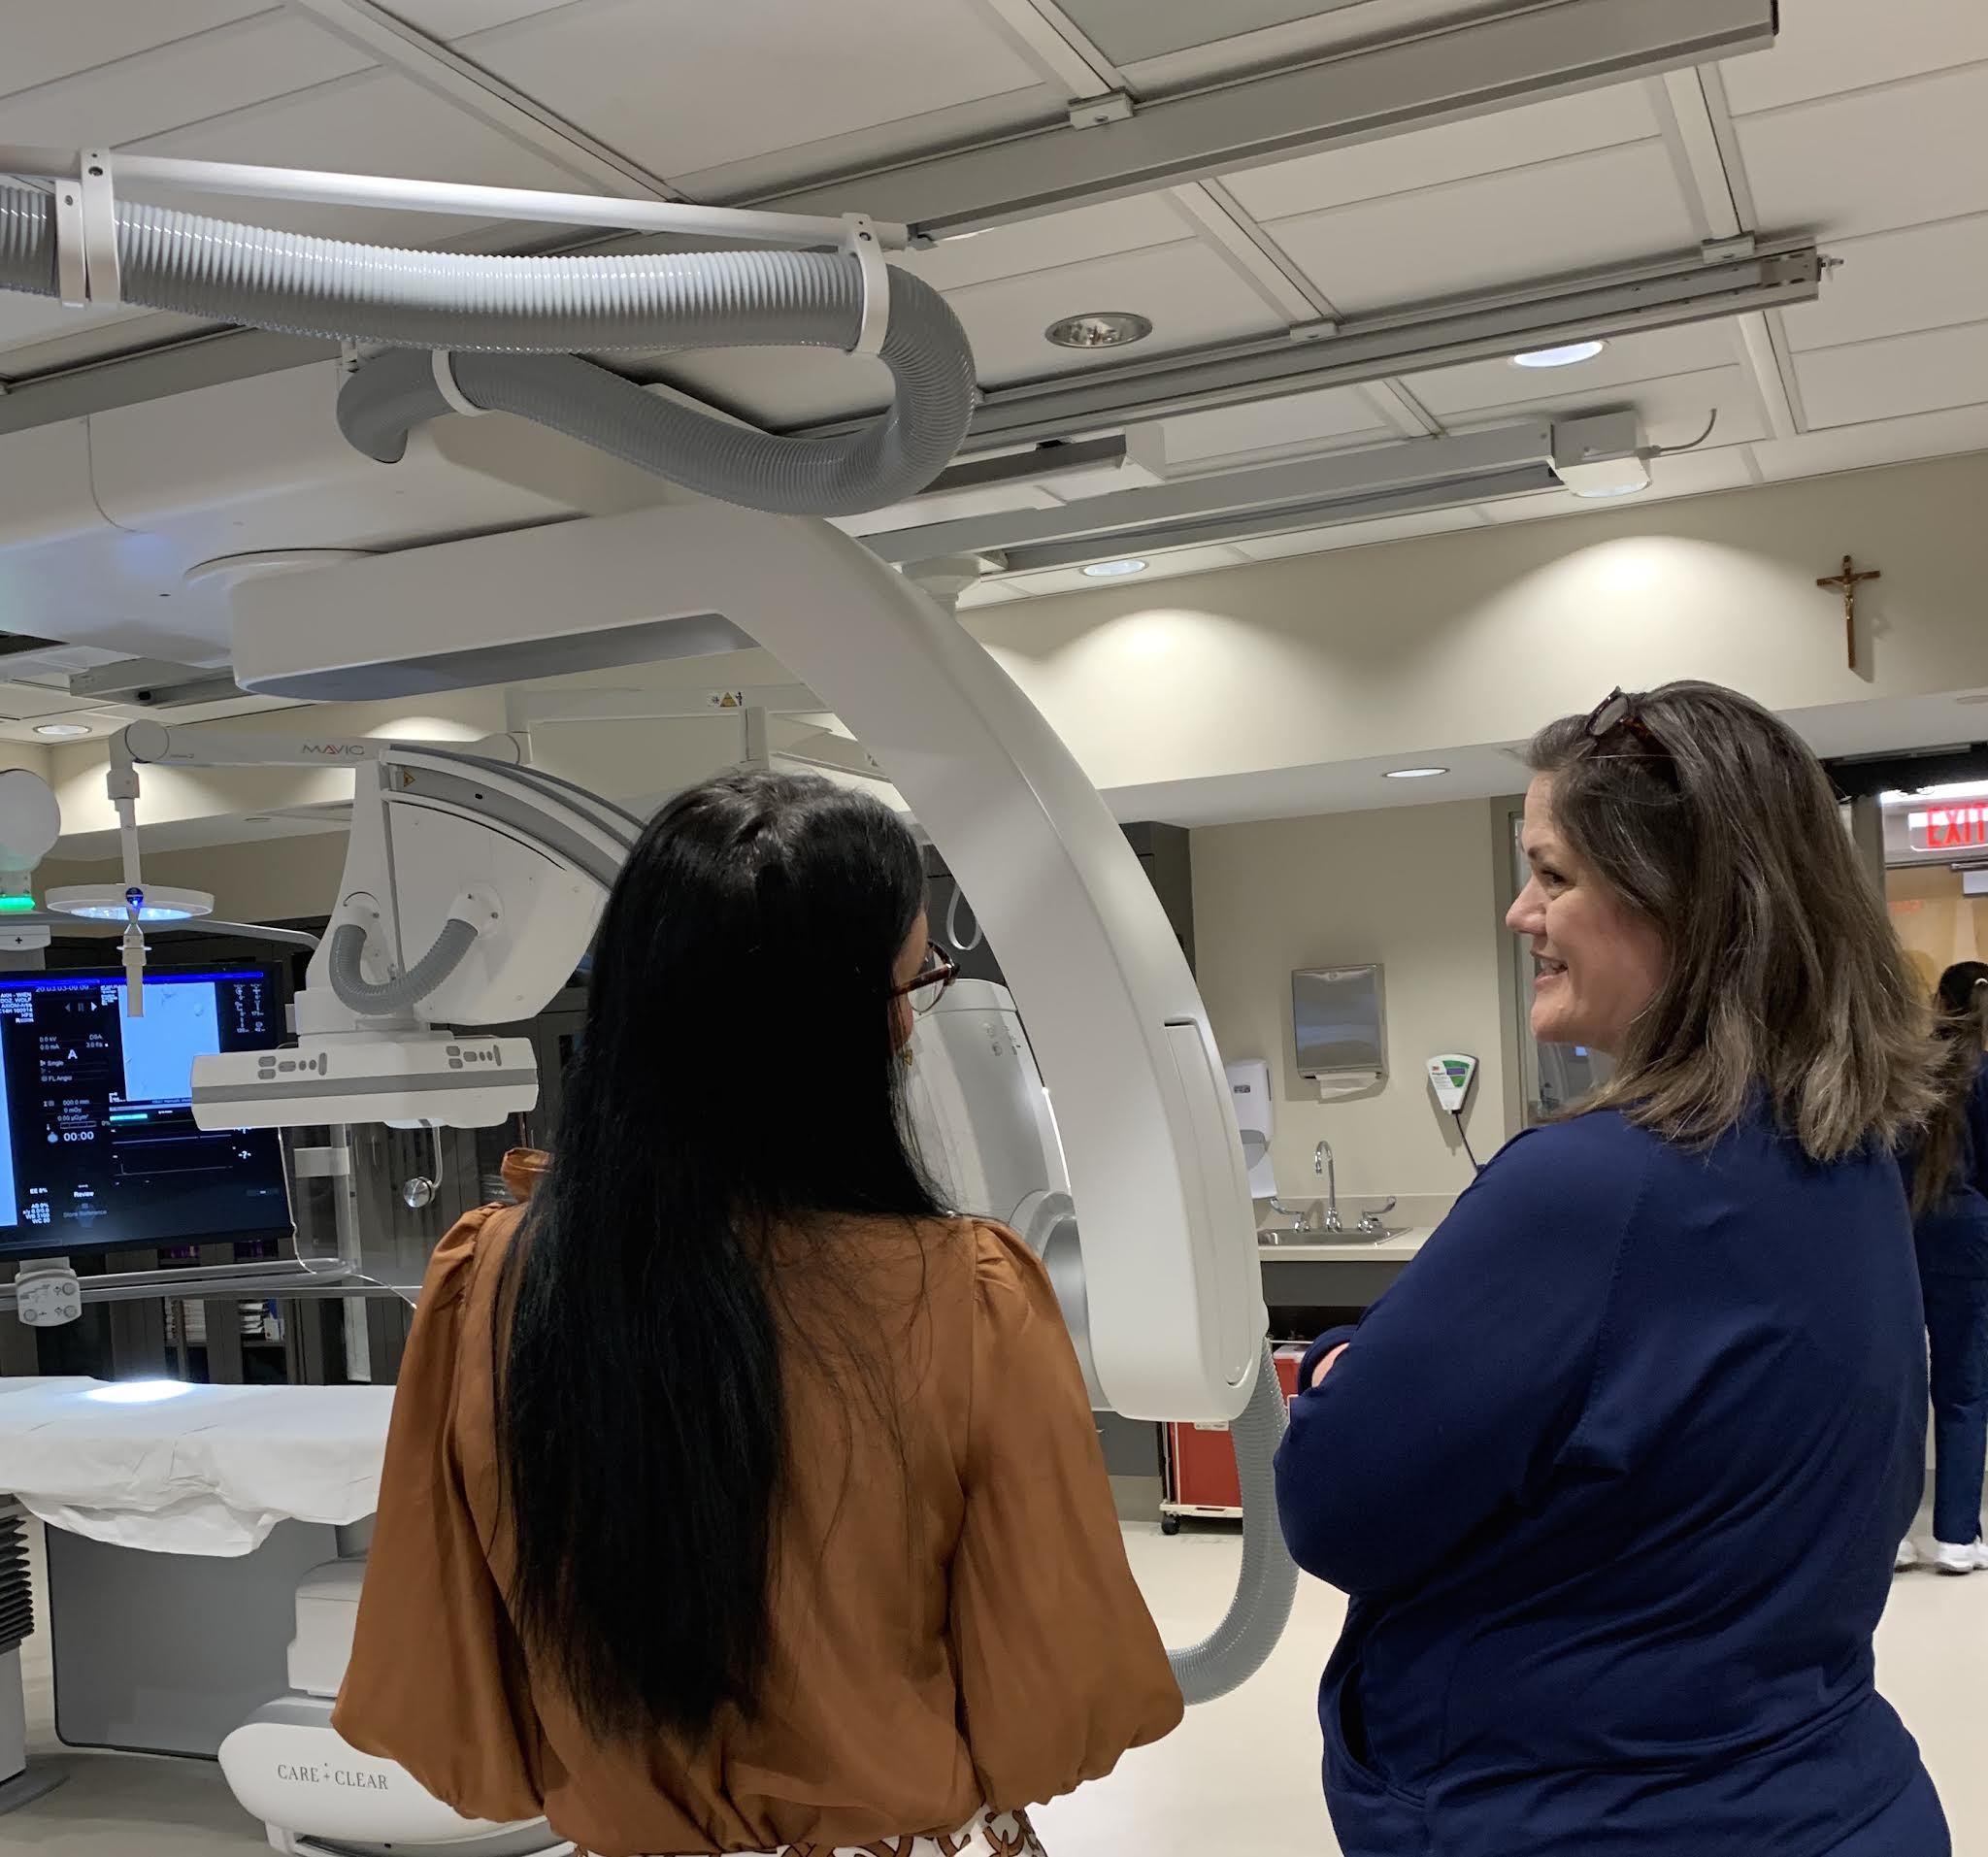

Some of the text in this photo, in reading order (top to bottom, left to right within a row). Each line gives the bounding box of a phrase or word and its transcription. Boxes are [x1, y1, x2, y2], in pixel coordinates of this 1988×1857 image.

[302, 745, 365, 755] MAVIG
[1927, 802, 1988, 846] EXIT
[67, 1048, 79, 1060] A
[63, 1130, 94, 1142] 00:00
[278, 1764, 319, 1783] CARE
[335, 1770, 389, 1790] CLEAR
